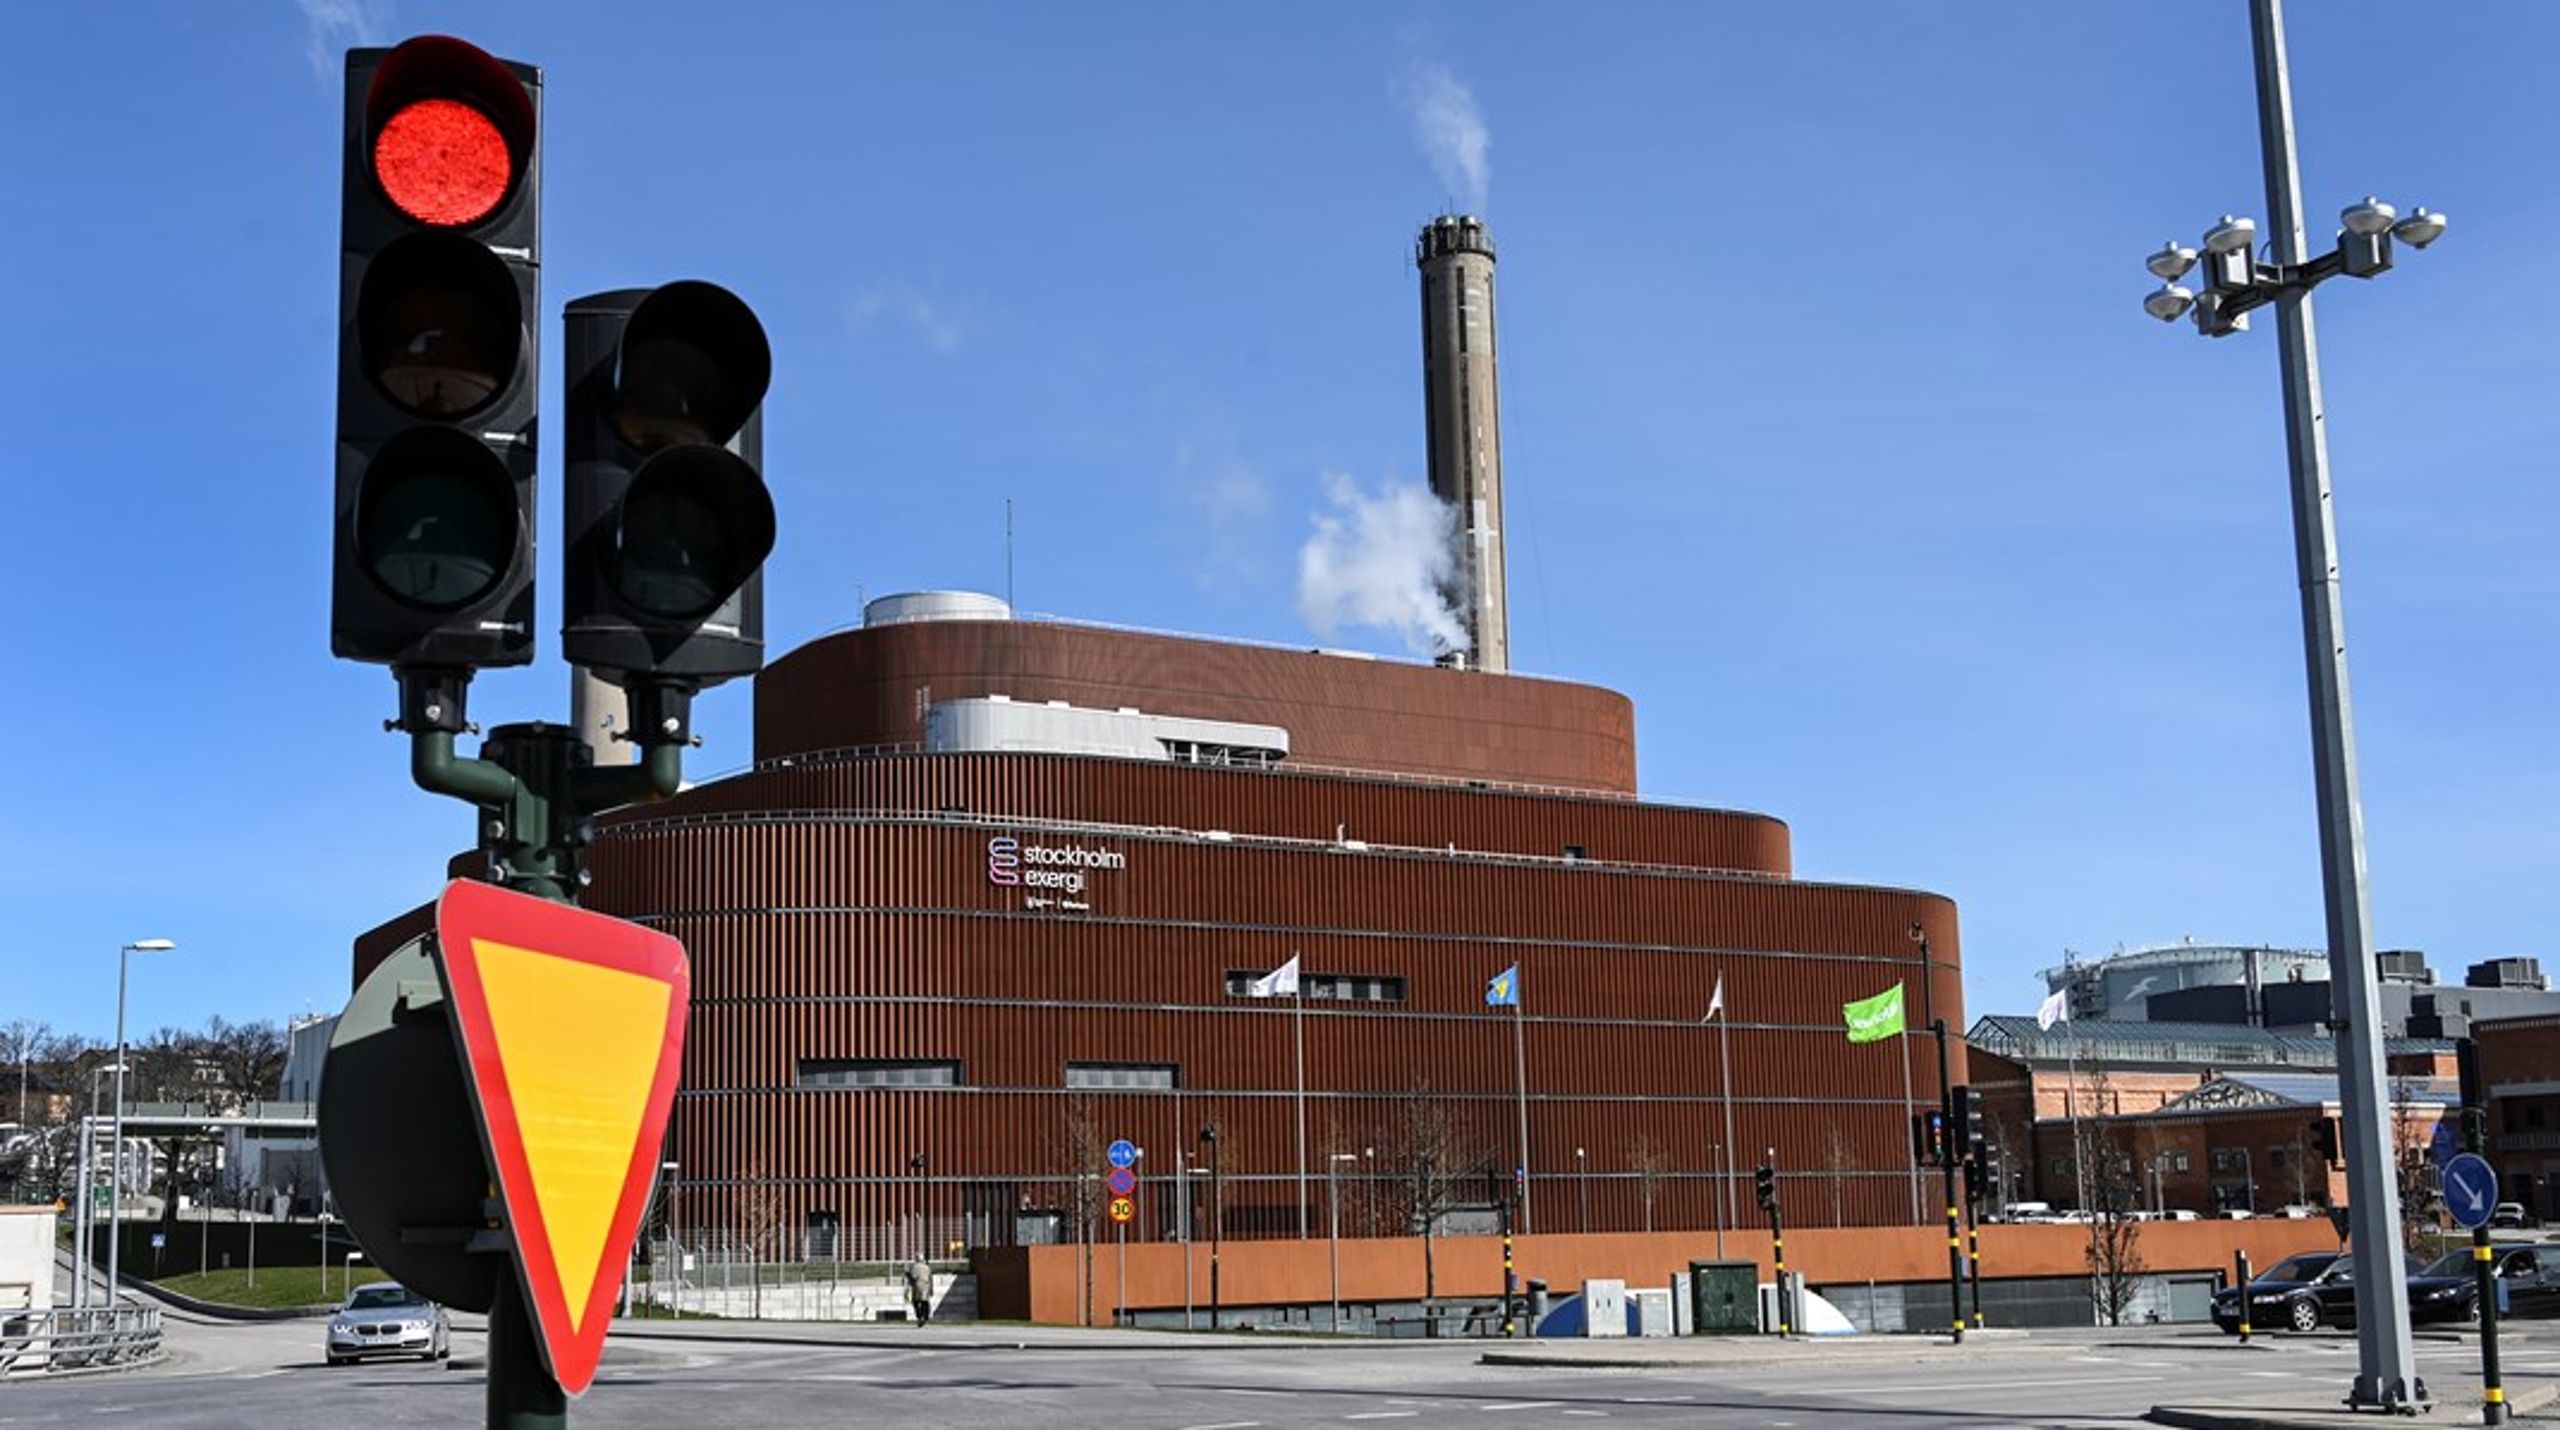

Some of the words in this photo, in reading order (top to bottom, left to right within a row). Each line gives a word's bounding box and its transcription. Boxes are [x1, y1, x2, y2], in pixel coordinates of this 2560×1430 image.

[1024, 844, 1125, 868] stockholm
[1025, 870, 1084, 892] exergi
[1113, 1202, 1130, 1216] 30
